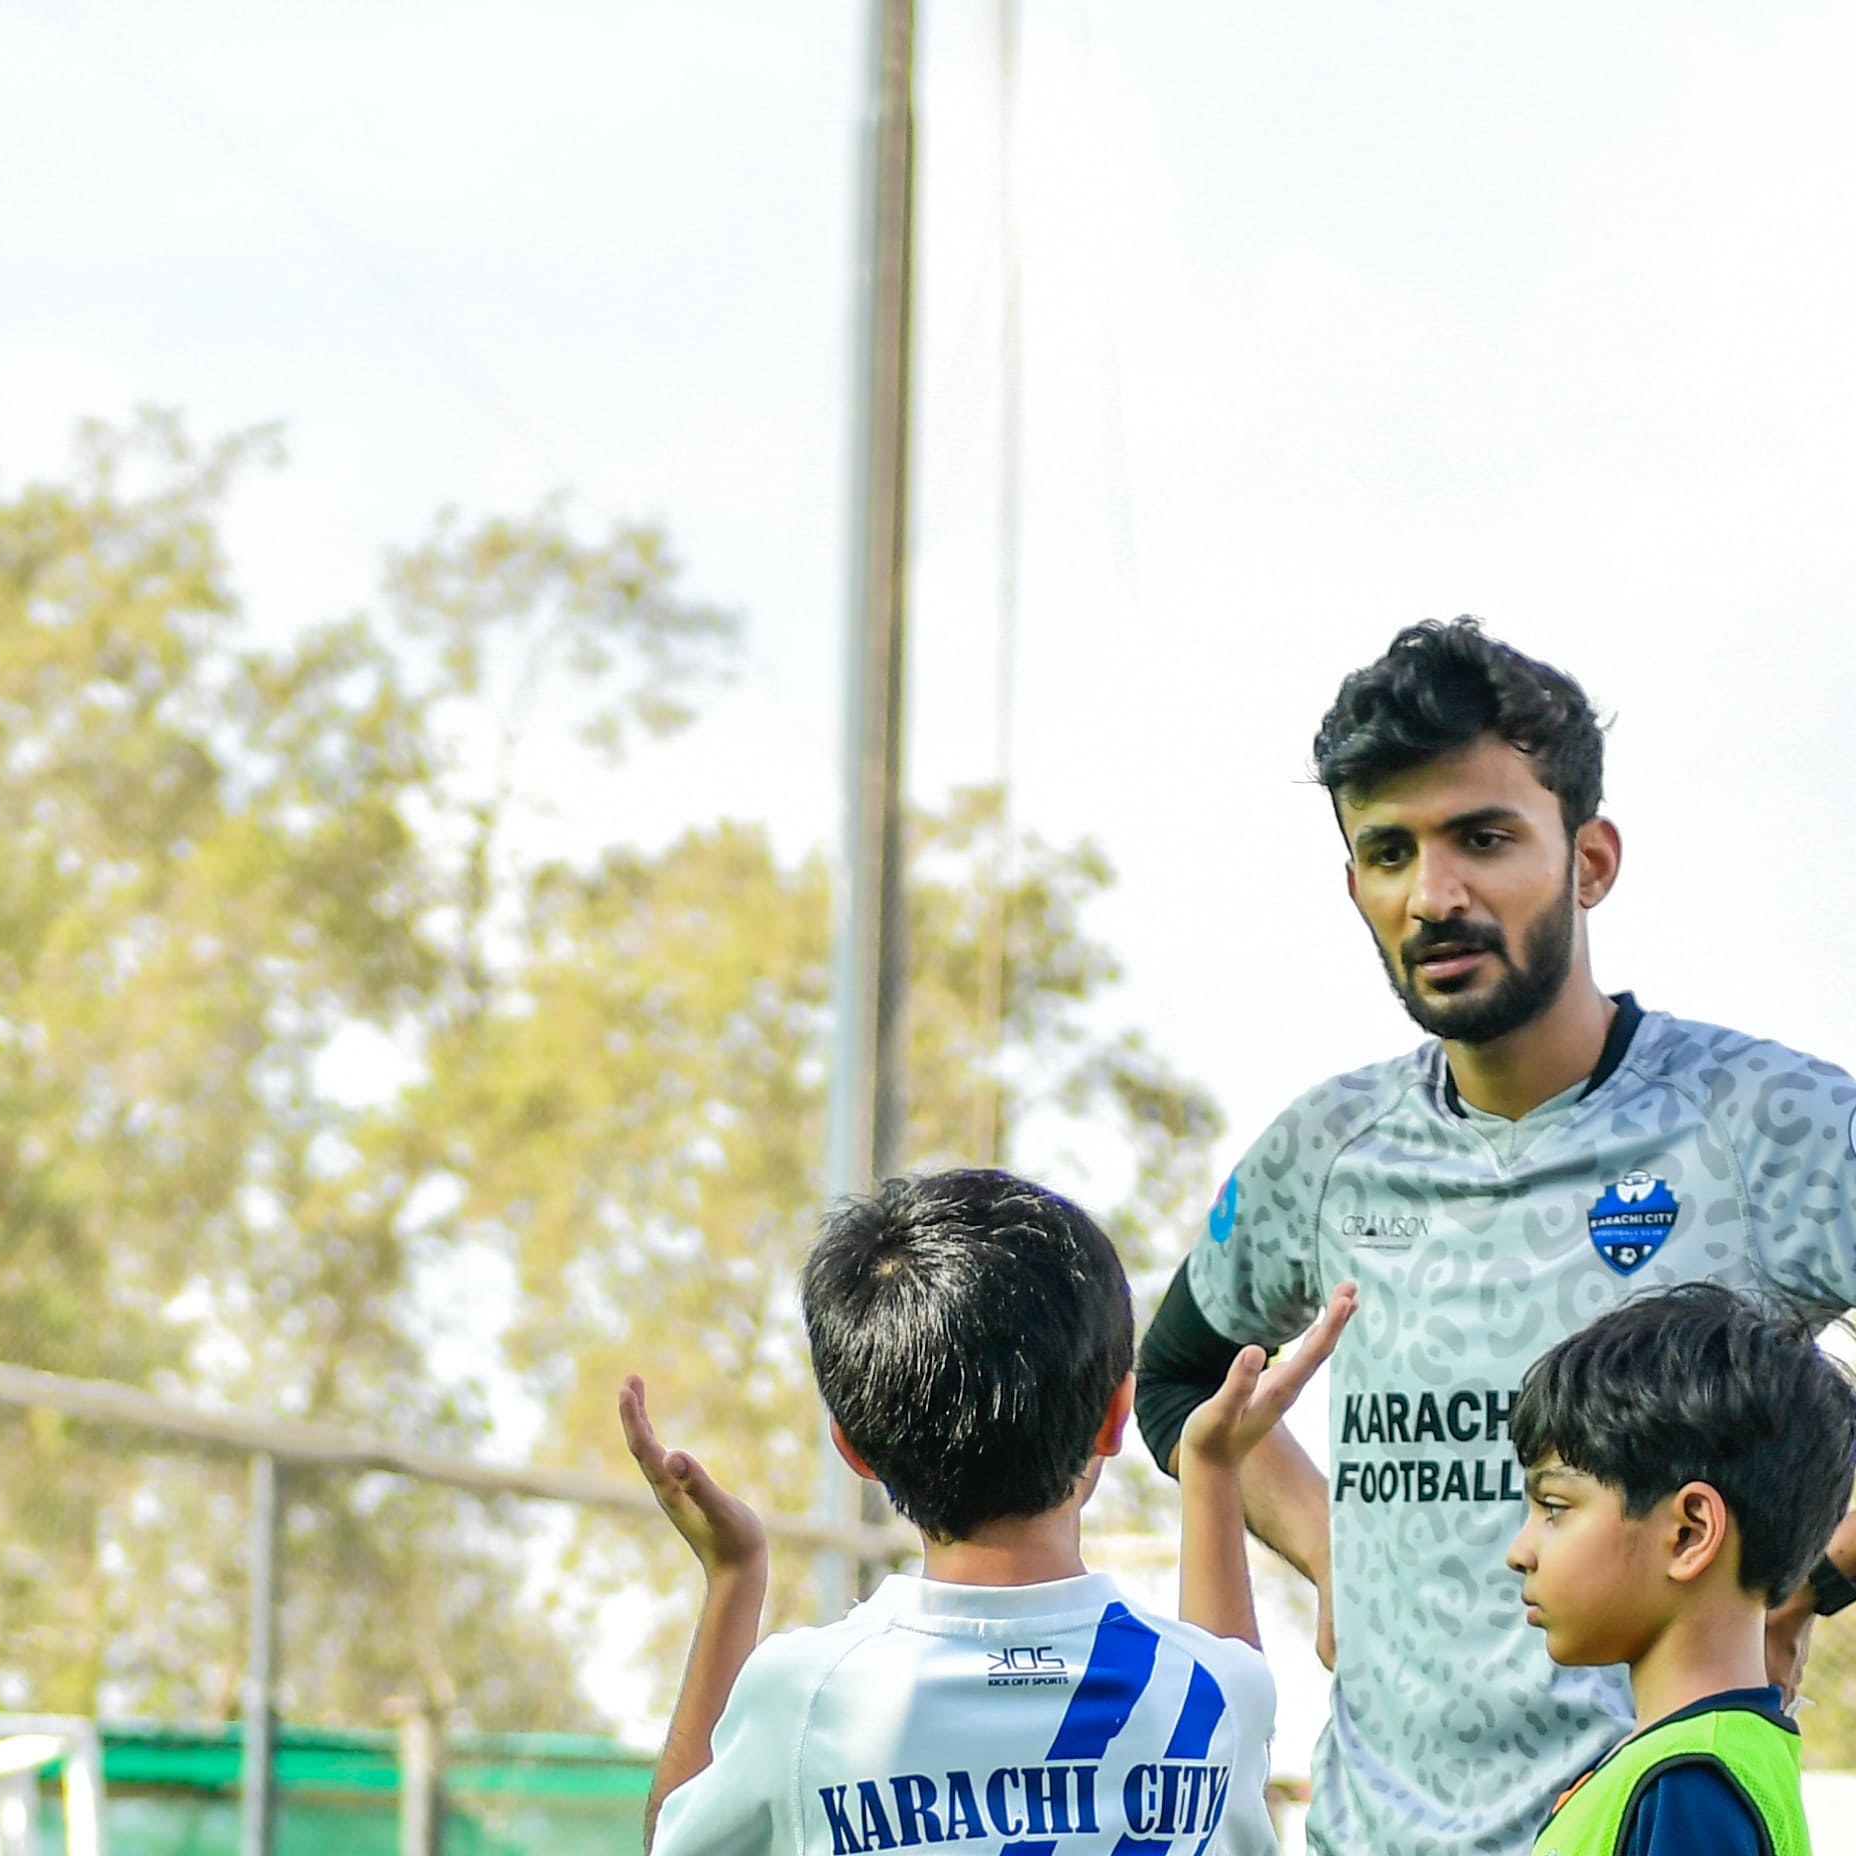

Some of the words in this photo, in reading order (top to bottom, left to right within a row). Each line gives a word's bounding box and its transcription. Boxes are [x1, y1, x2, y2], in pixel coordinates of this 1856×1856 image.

[1645, 1213, 1673, 1225] CITY
[1341, 1390, 1523, 1443] KARACH
[1334, 1460, 1523, 1503] FOOTBALL
[988, 1678, 1010, 1687] KICK
[1011, 1678, 1030, 1686] OFF
[1032, 1676, 1069, 1686] SPORTS
[818, 1765, 1101, 1856] KARACHI
[1123, 1763, 1228, 1834] CITY
